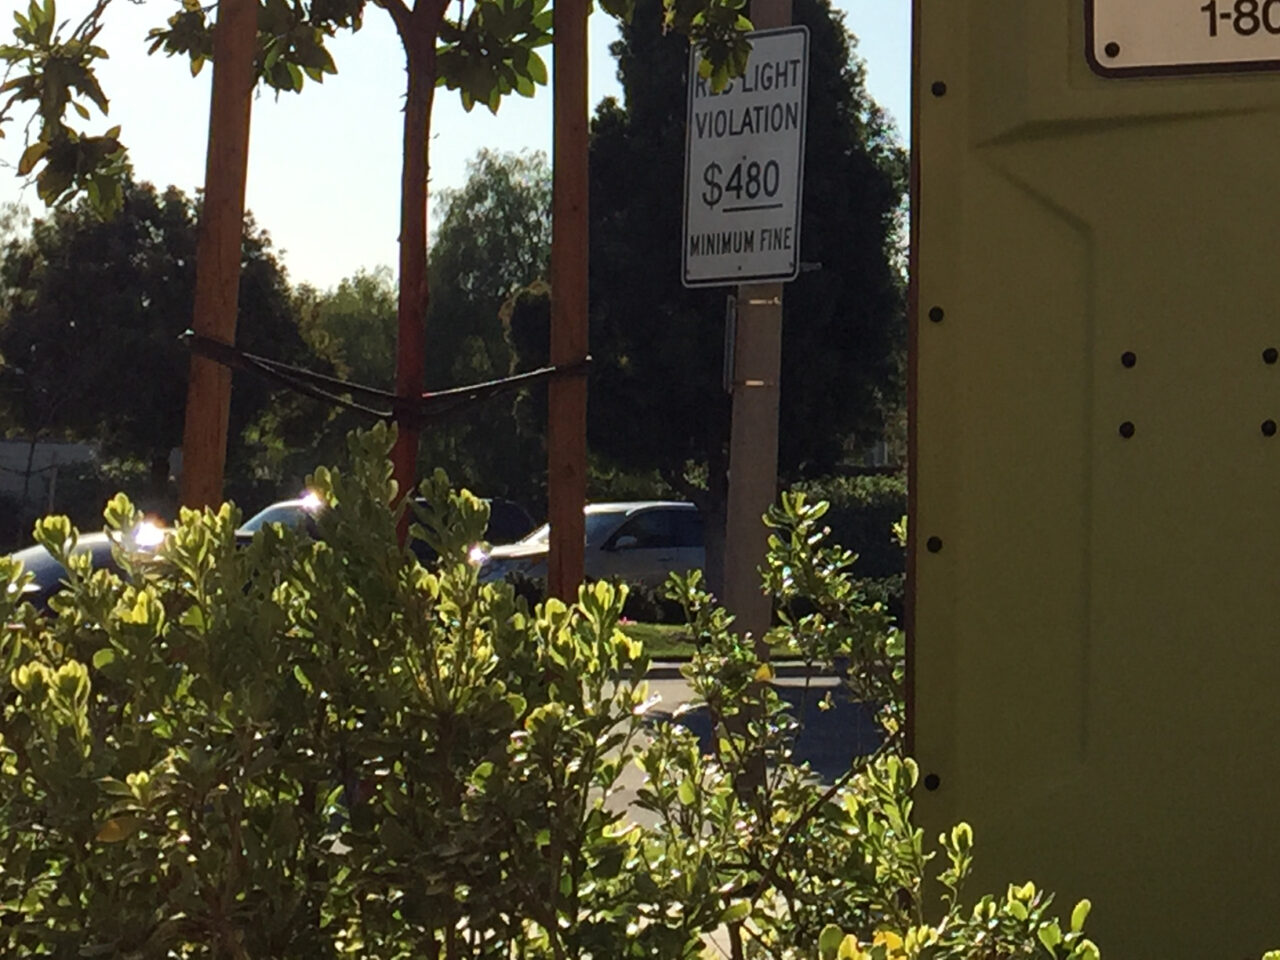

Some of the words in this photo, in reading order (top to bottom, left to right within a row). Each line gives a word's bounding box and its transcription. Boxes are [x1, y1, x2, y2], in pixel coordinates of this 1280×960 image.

[742, 59, 800, 92] LIGHT
[695, 101, 799, 139] VIOLATION
[702, 160, 780, 210] $480
[690, 230, 755, 257] MINIMUM
[760, 227, 792, 252] FINE
